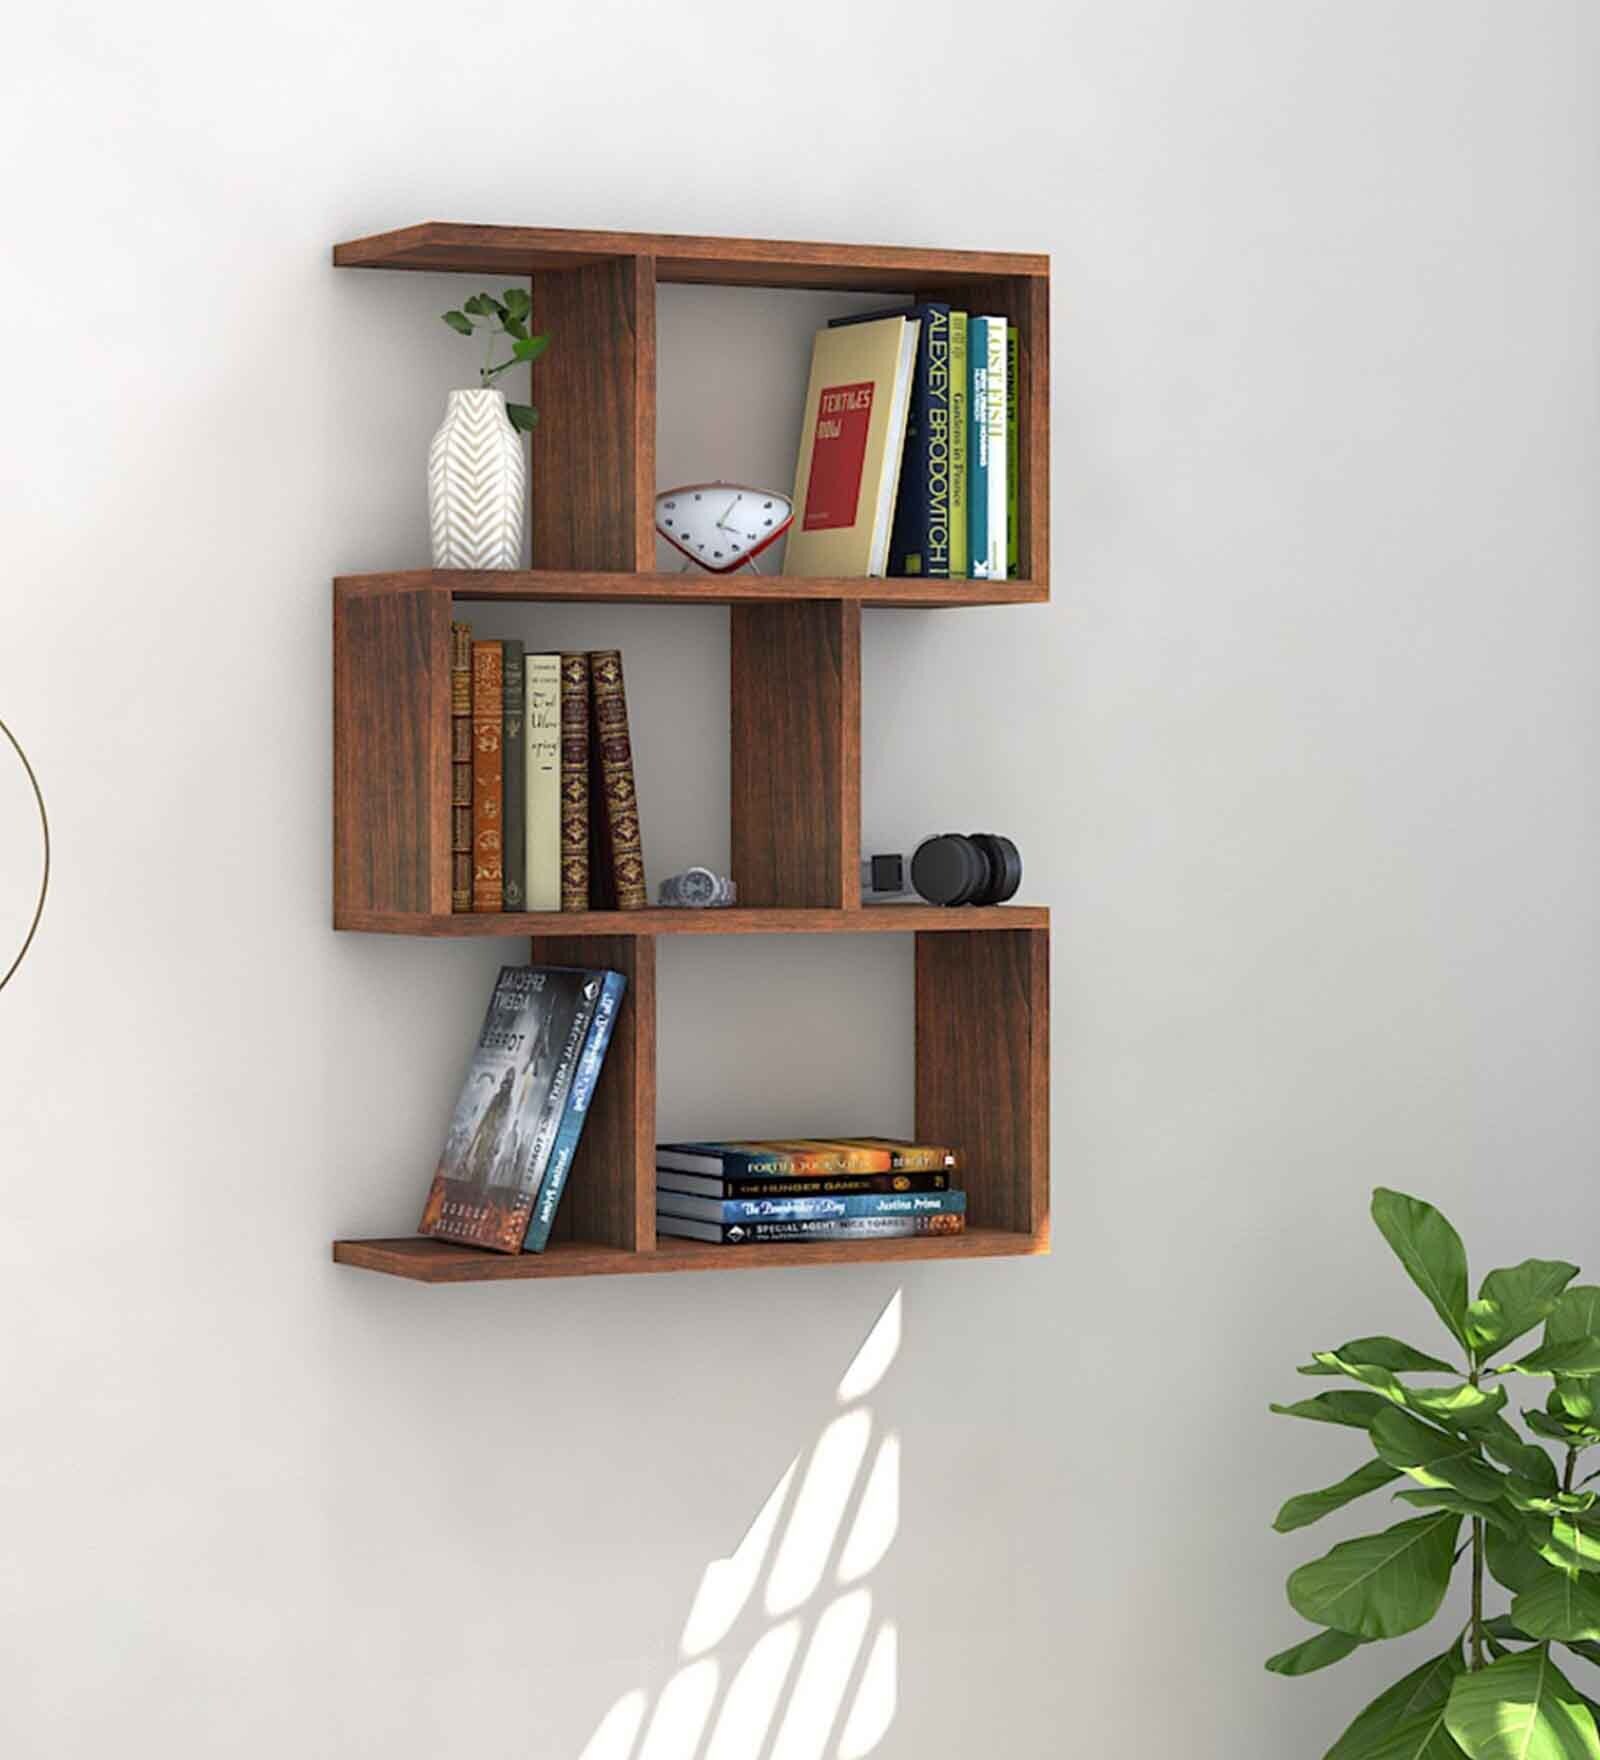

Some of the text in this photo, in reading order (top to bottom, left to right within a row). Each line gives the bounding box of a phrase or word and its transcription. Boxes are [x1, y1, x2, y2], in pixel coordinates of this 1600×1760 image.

[928, 309, 948, 402] ALEXEY
[987, 325, 1003, 438] LOST FISH
[822, 390, 871, 415] TEXTILES
[928, 408, 948, 563] BRODOVITCH
[953, 393, 964, 507] Gardens in France
[756, 1223, 799, 1234] SPECIAL
[801, 1221, 836, 1231] AGENT
[762, 1182, 821, 1193] HUNGER
[824, 1181, 871, 1191] GAMES
